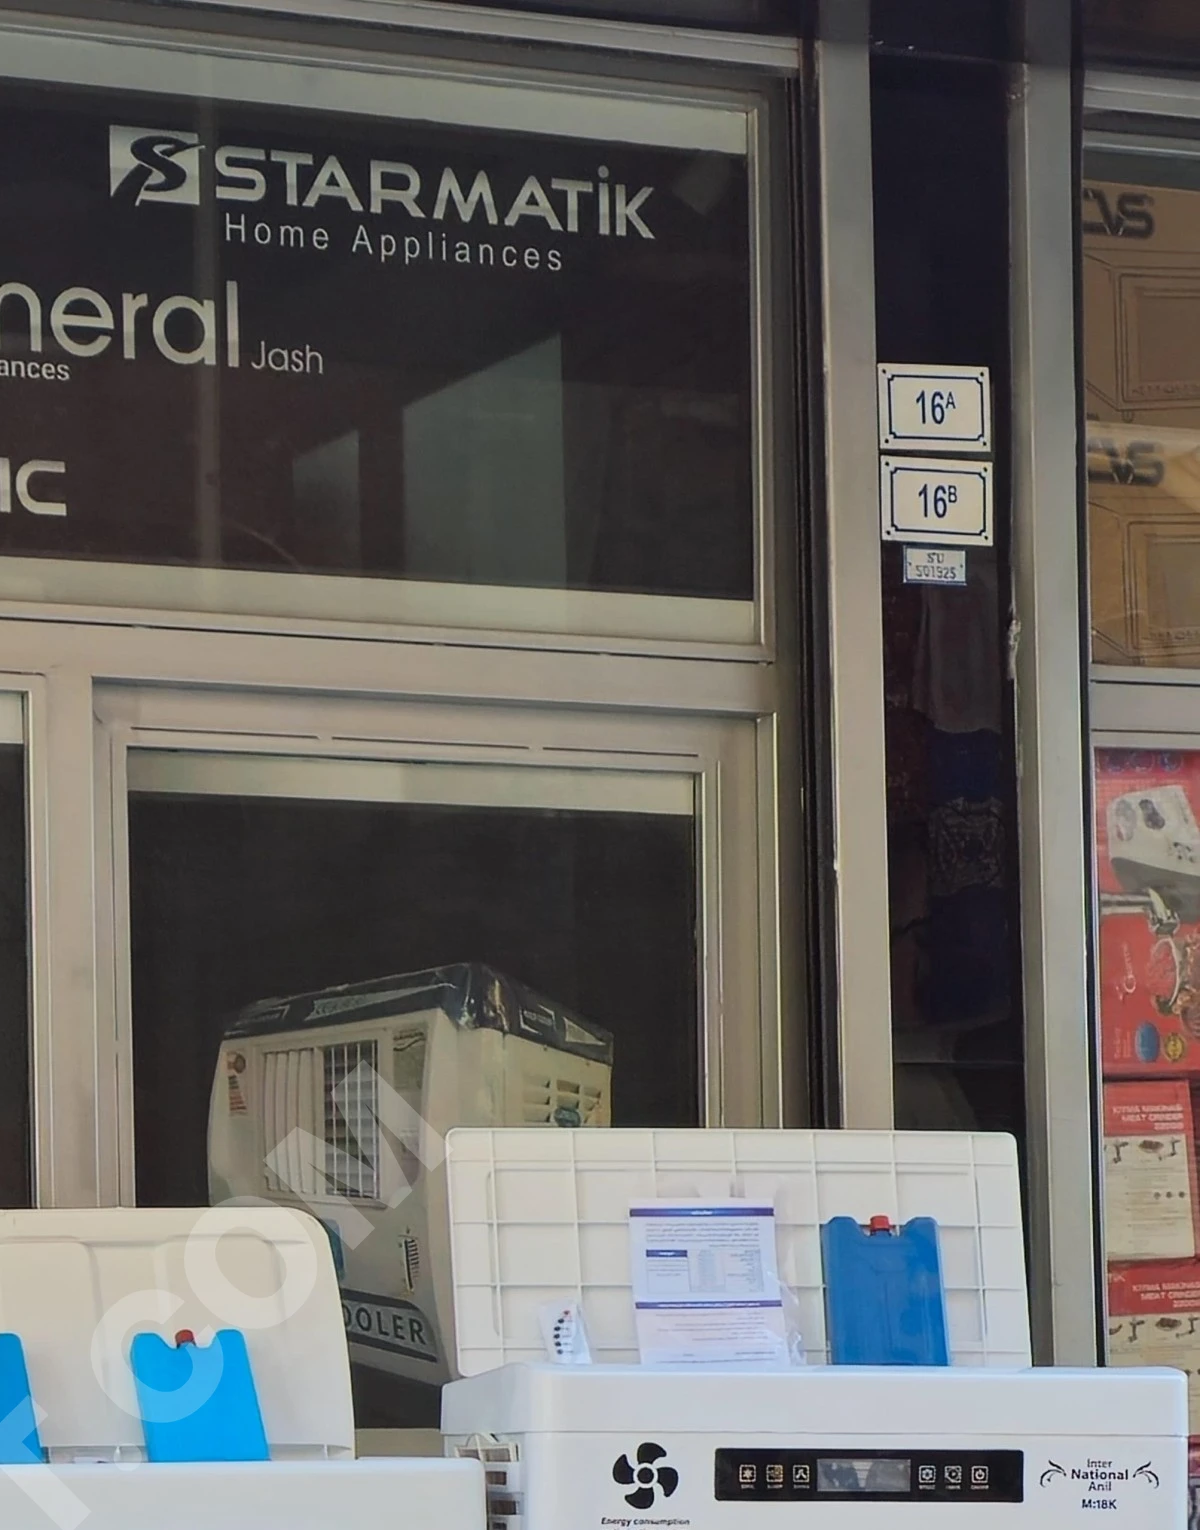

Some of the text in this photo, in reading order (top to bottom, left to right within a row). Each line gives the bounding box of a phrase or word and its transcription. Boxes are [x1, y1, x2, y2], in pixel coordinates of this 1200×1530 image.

[225, 213, 564, 272] Home Appliances
[250, 339, 325, 375] Jash
[1087, 1457, 1113, 1469] Inter
[1070, 1467, 1129, 1482] National
[1088, 1481, 1113, 1493] Anil
[1081, 1498, 1118, 1511] M:18K
[601, 1516, 691, 1527] Energy consumption
